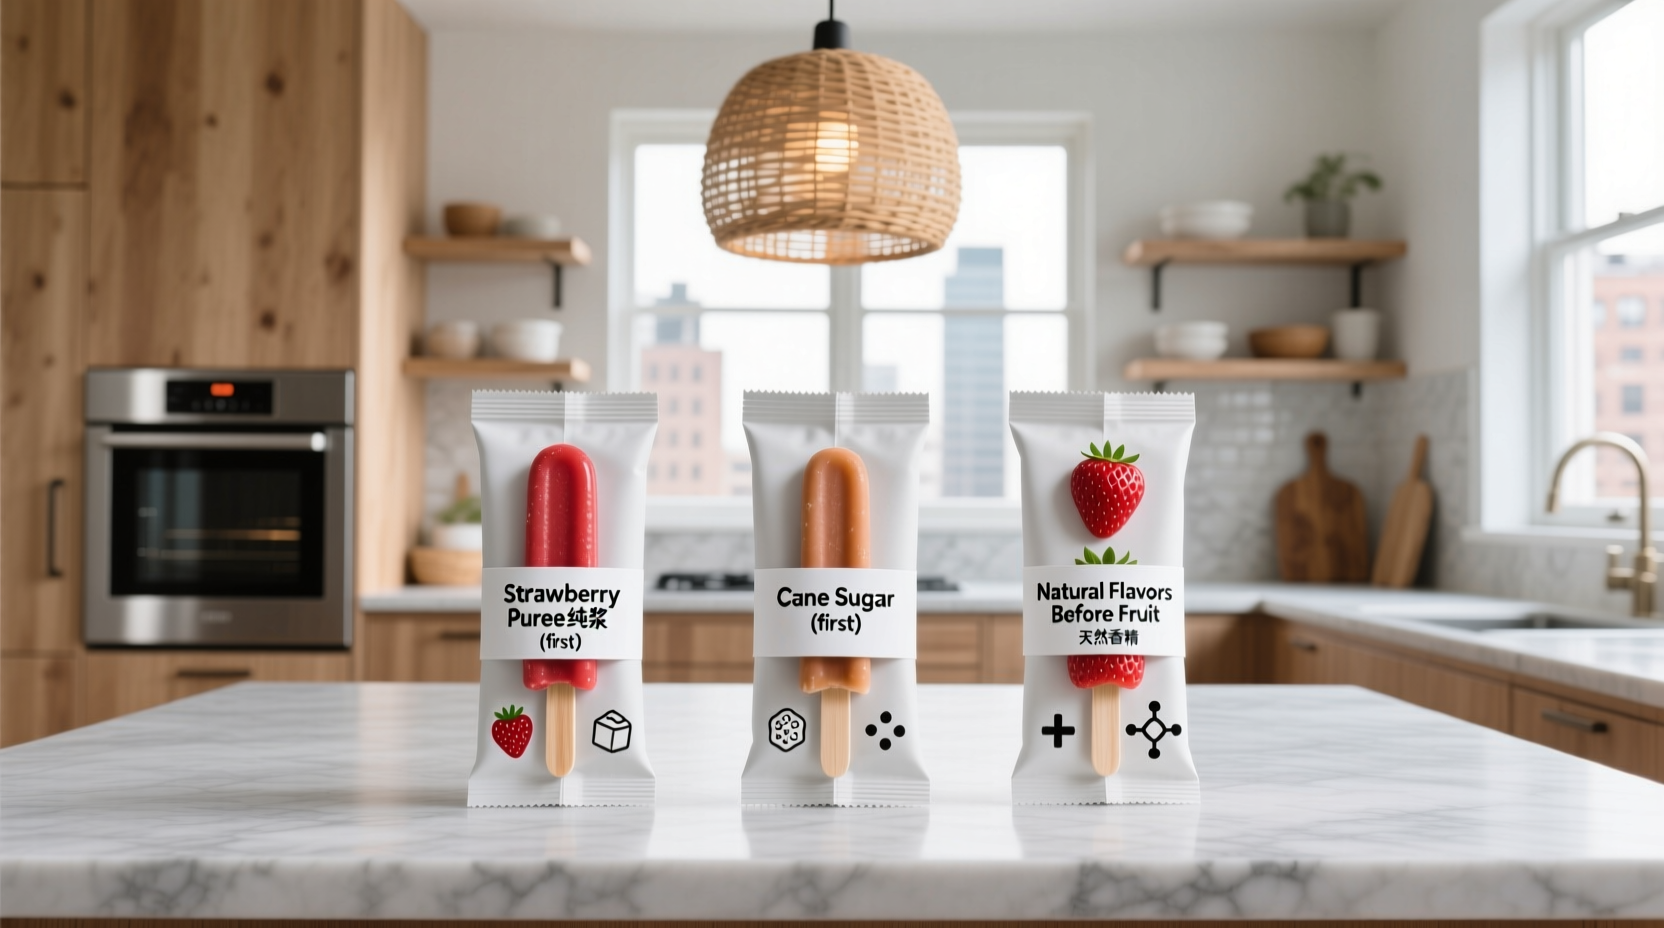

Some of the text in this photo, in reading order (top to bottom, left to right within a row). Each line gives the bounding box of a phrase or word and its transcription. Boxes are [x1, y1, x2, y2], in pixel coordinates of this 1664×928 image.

[504, 583, 621, 609] Strawberry
[777, 587, 895, 612] Cane Sugar
[1037, 581, 1173, 601] Natural Flavors
[1052, 603, 1160, 623] Before Fruit
[811, 613, 862, 635] (first)
[540, 633, 582, 652] (first)
